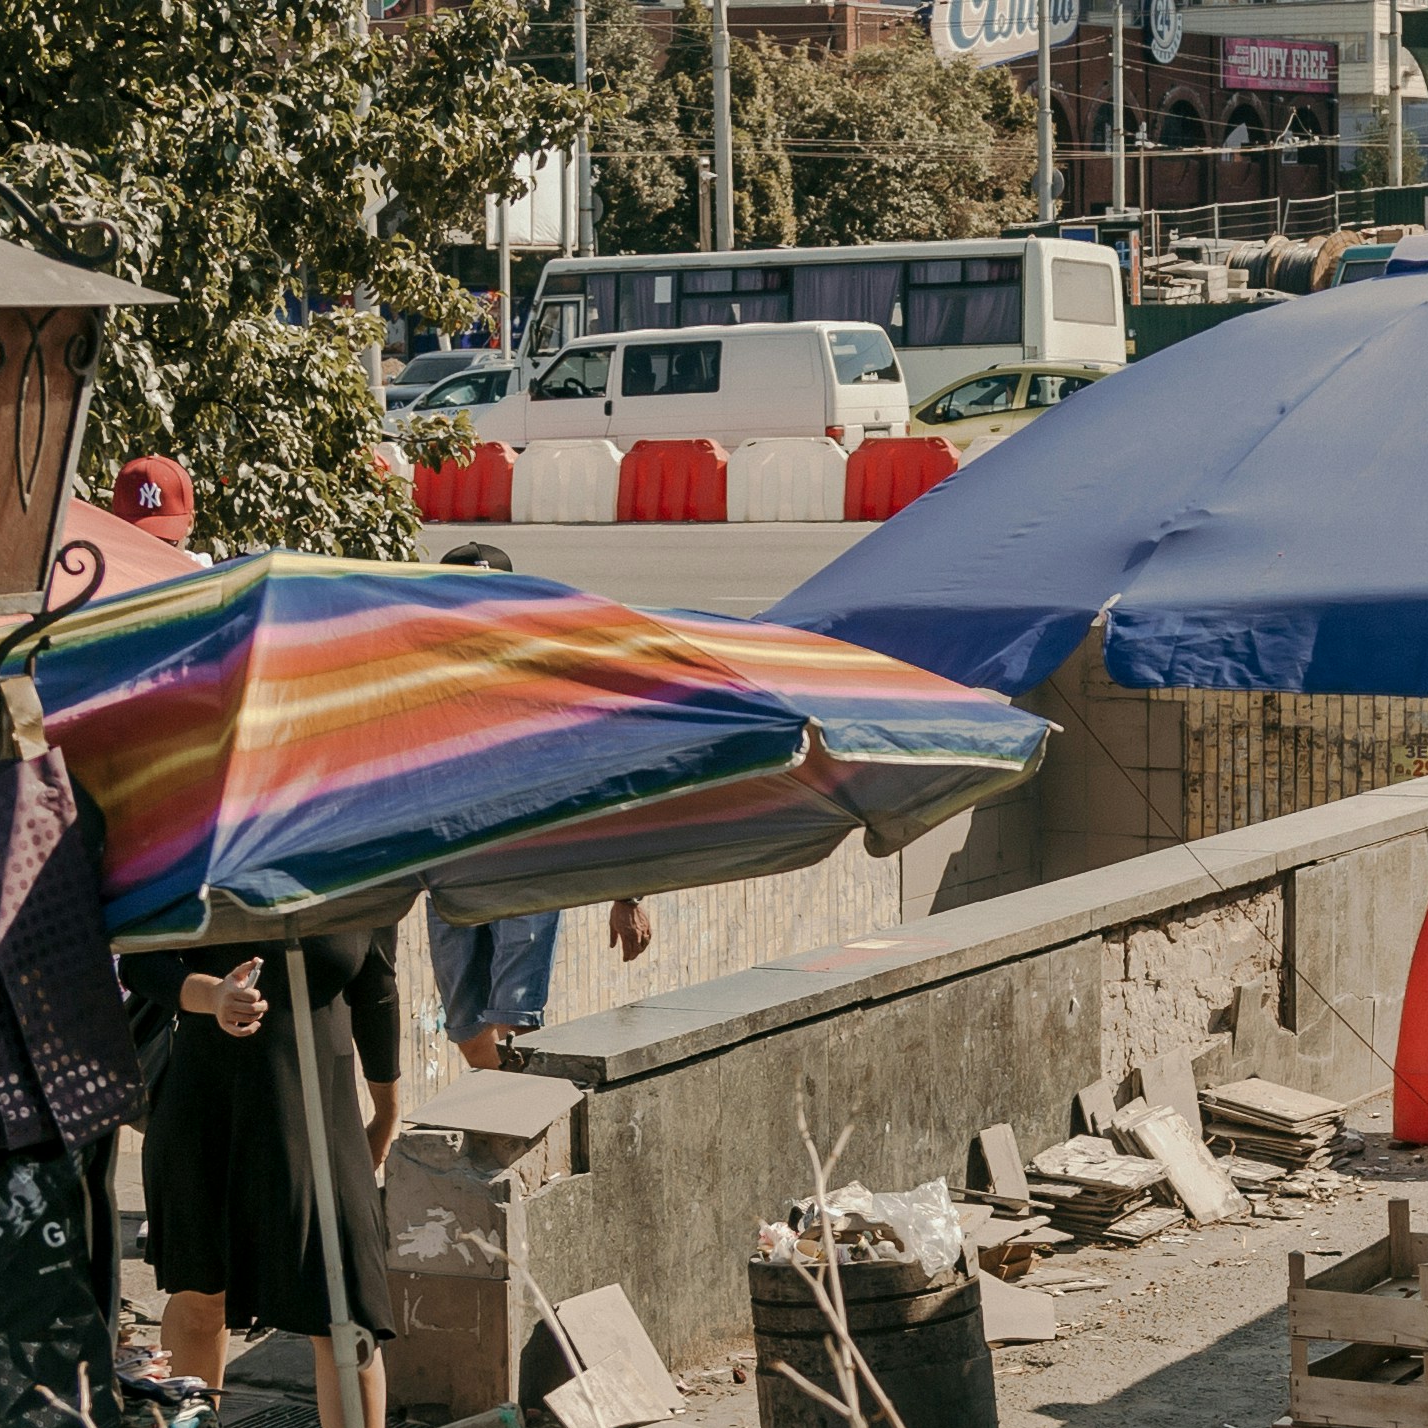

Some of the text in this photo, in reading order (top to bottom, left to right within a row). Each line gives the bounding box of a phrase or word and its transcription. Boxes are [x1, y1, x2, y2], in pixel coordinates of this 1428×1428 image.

[1250, 46, 1328, 80] DUTY FREE
[140, 482, 162, 508] NY
